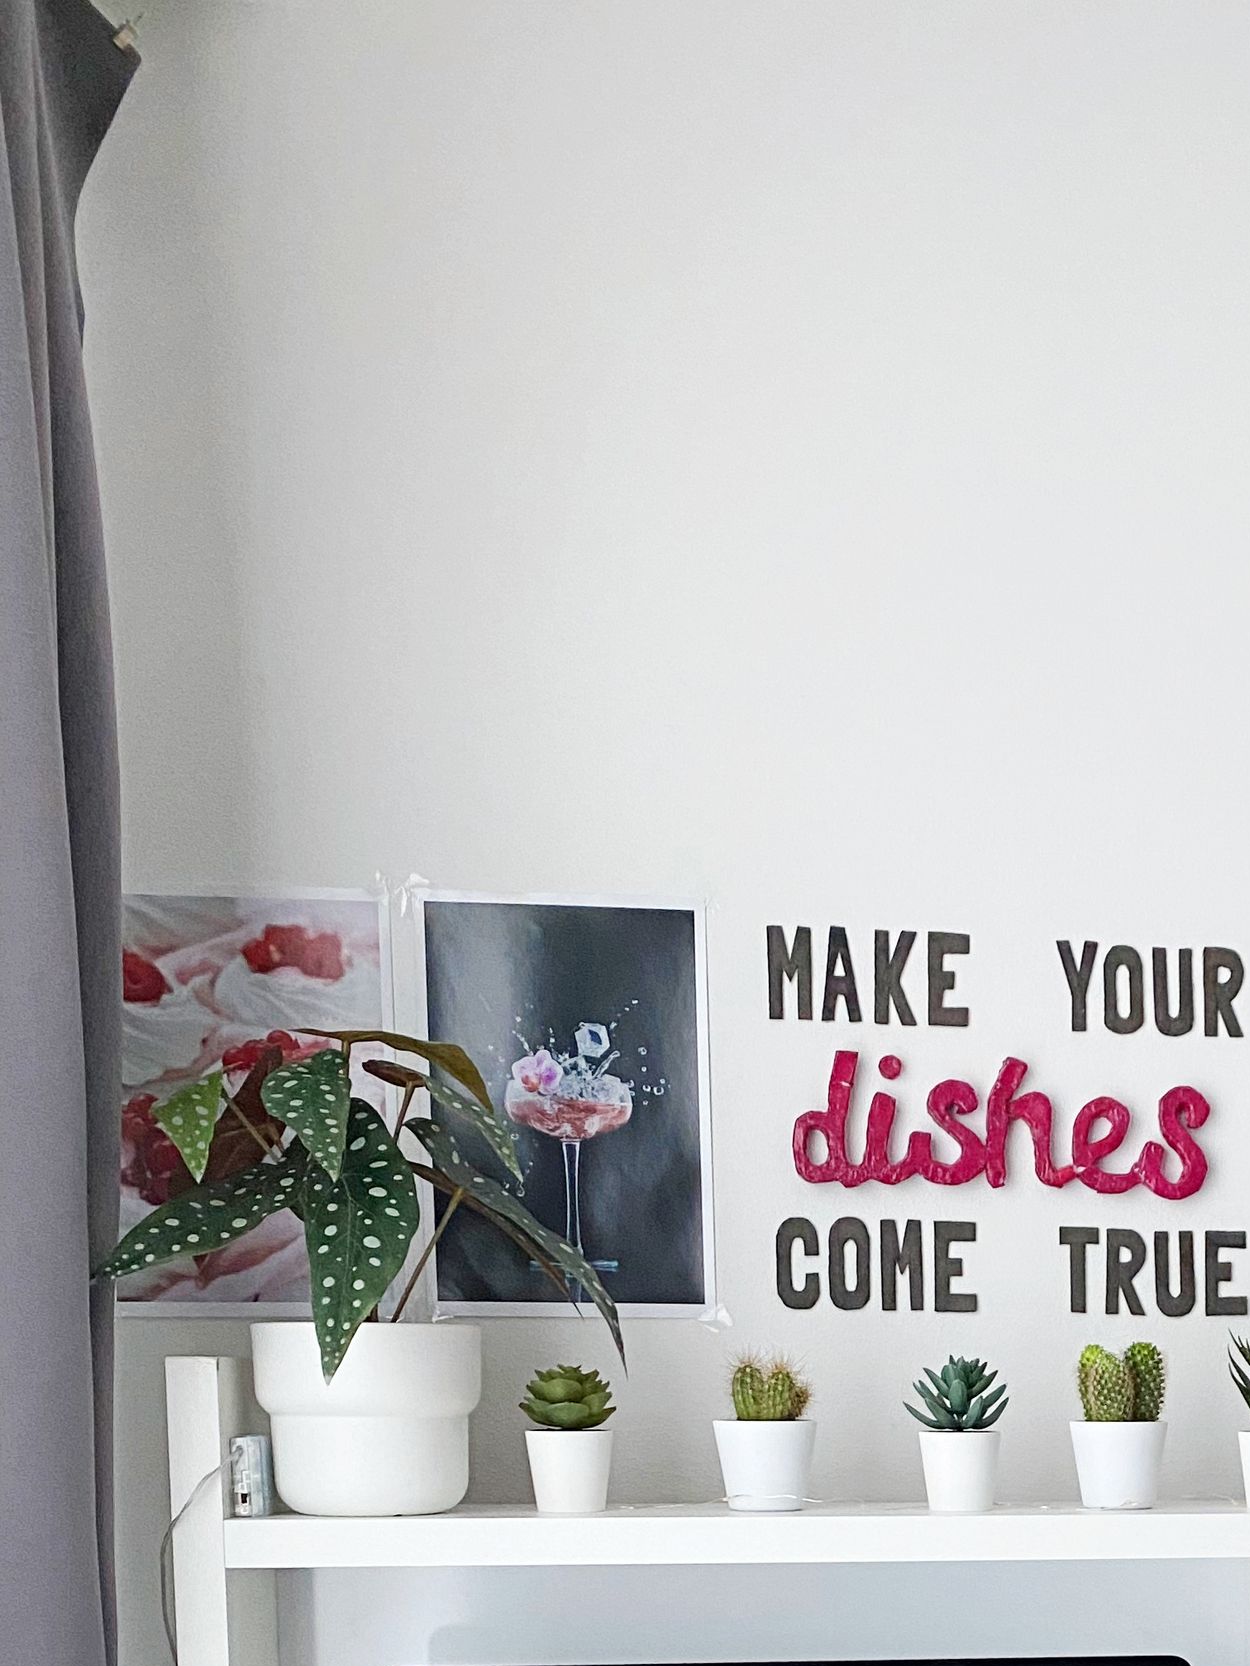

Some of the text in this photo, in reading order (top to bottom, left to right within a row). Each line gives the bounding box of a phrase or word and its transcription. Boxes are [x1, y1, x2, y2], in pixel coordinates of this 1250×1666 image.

[767, 925, 1245, 1038] MAKE YOUR
[792, 1049, 1211, 1201] dishes
[776, 1216, 1248, 1318] COME TRUE
